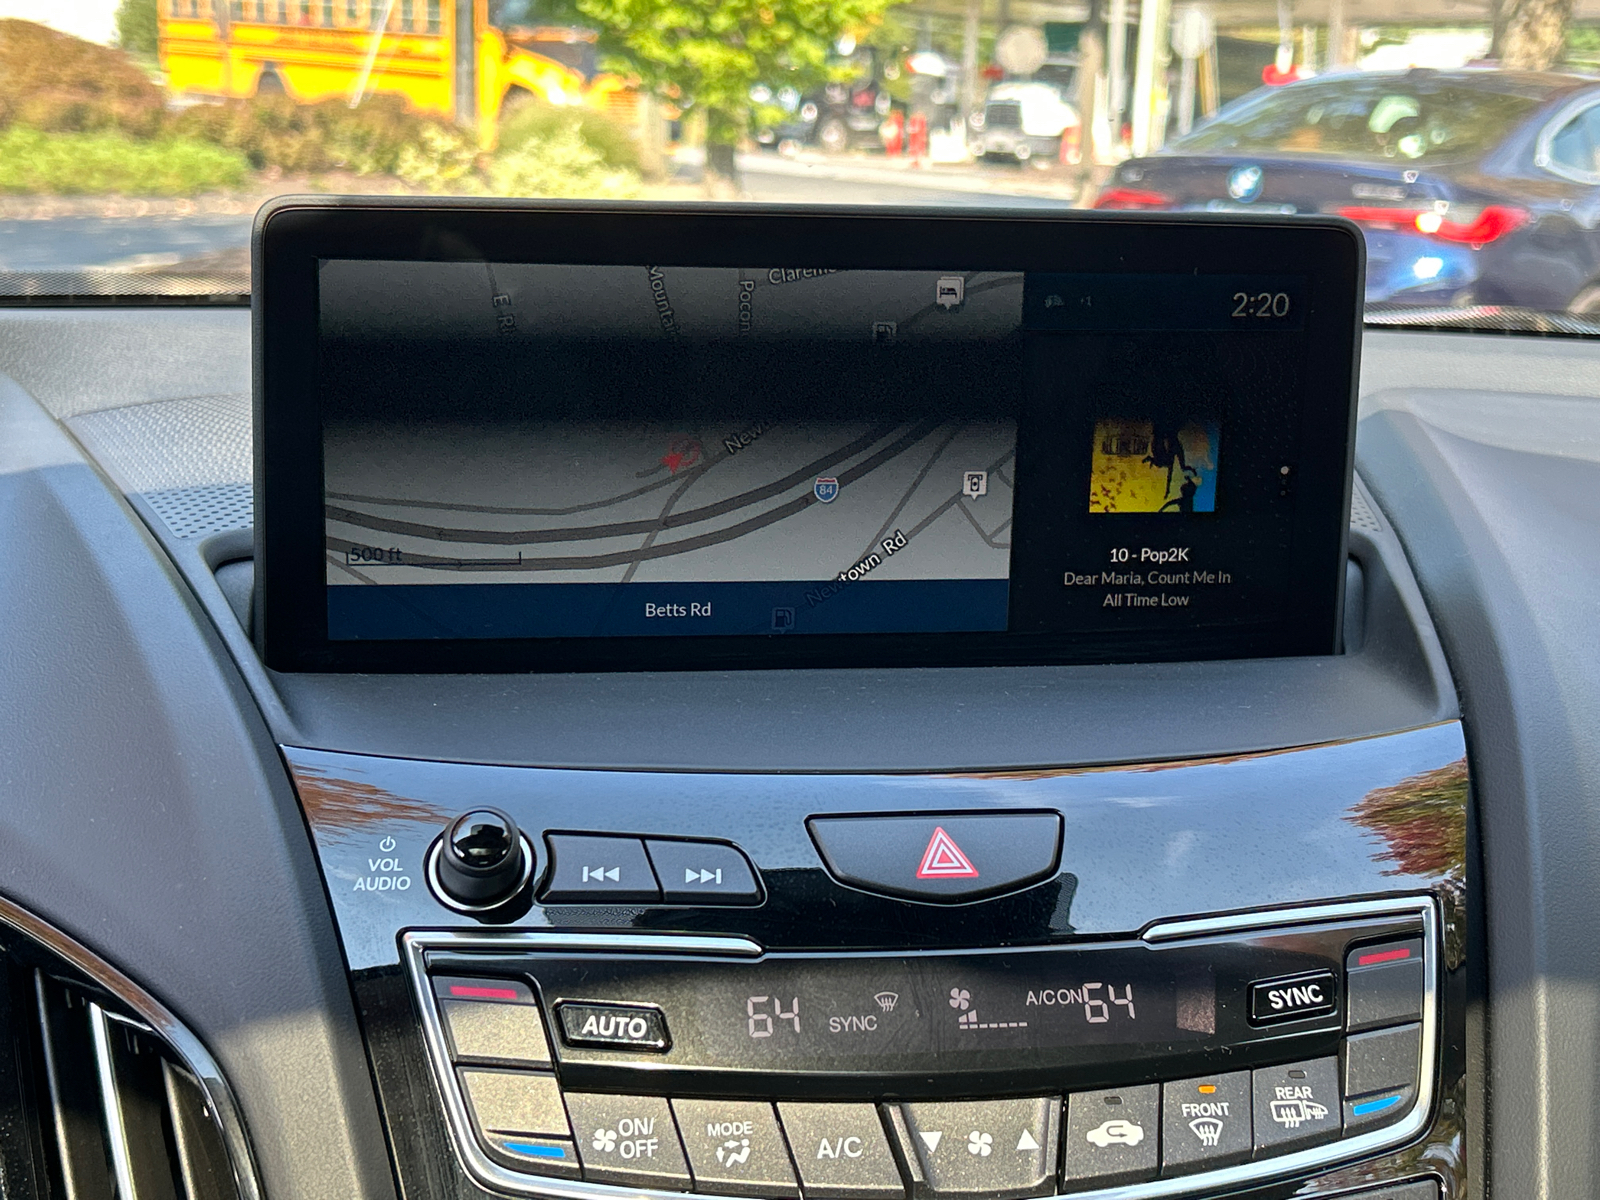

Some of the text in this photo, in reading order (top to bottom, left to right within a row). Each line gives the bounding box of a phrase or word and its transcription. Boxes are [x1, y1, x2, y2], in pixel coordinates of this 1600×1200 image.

[1231, 292, 1290, 318] 2:20
[819, 484, 833, 495] 84
[882, 531, 907, 555] Rd
[350, 547, 402, 562] 500 ft
[1110, 548, 1128, 563] 10
[1141, 547, 1189, 564] Pop2K
[1064, 571, 1231, 587] Dear Maria, Count Me In
[1103, 593, 1189, 607] All Time Low
[645, 602, 711, 617] Betts Rd
[368, 857, 404, 873] VOL
[353, 875, 411, 892] AUDIO
[1082, 982, 1136, 1024] 64
[1268, 983, 1324, 1010] SYNC
[746, 995, 801, 1038] 64
[829, 1014, 878, 1034] SYNC
[582, 1015, 648, 1038] AUTO
[1275, 1085, 1312, 1100] REAR
[1181, 1101, 1229, 1117] FRONT
[618, 1118, 654, 1137] ON/
[707, 1121, 753, 1137] MODE
[619, 1139, 659, 1159] OFF
[816, 1136, 863, 1160] A/C
